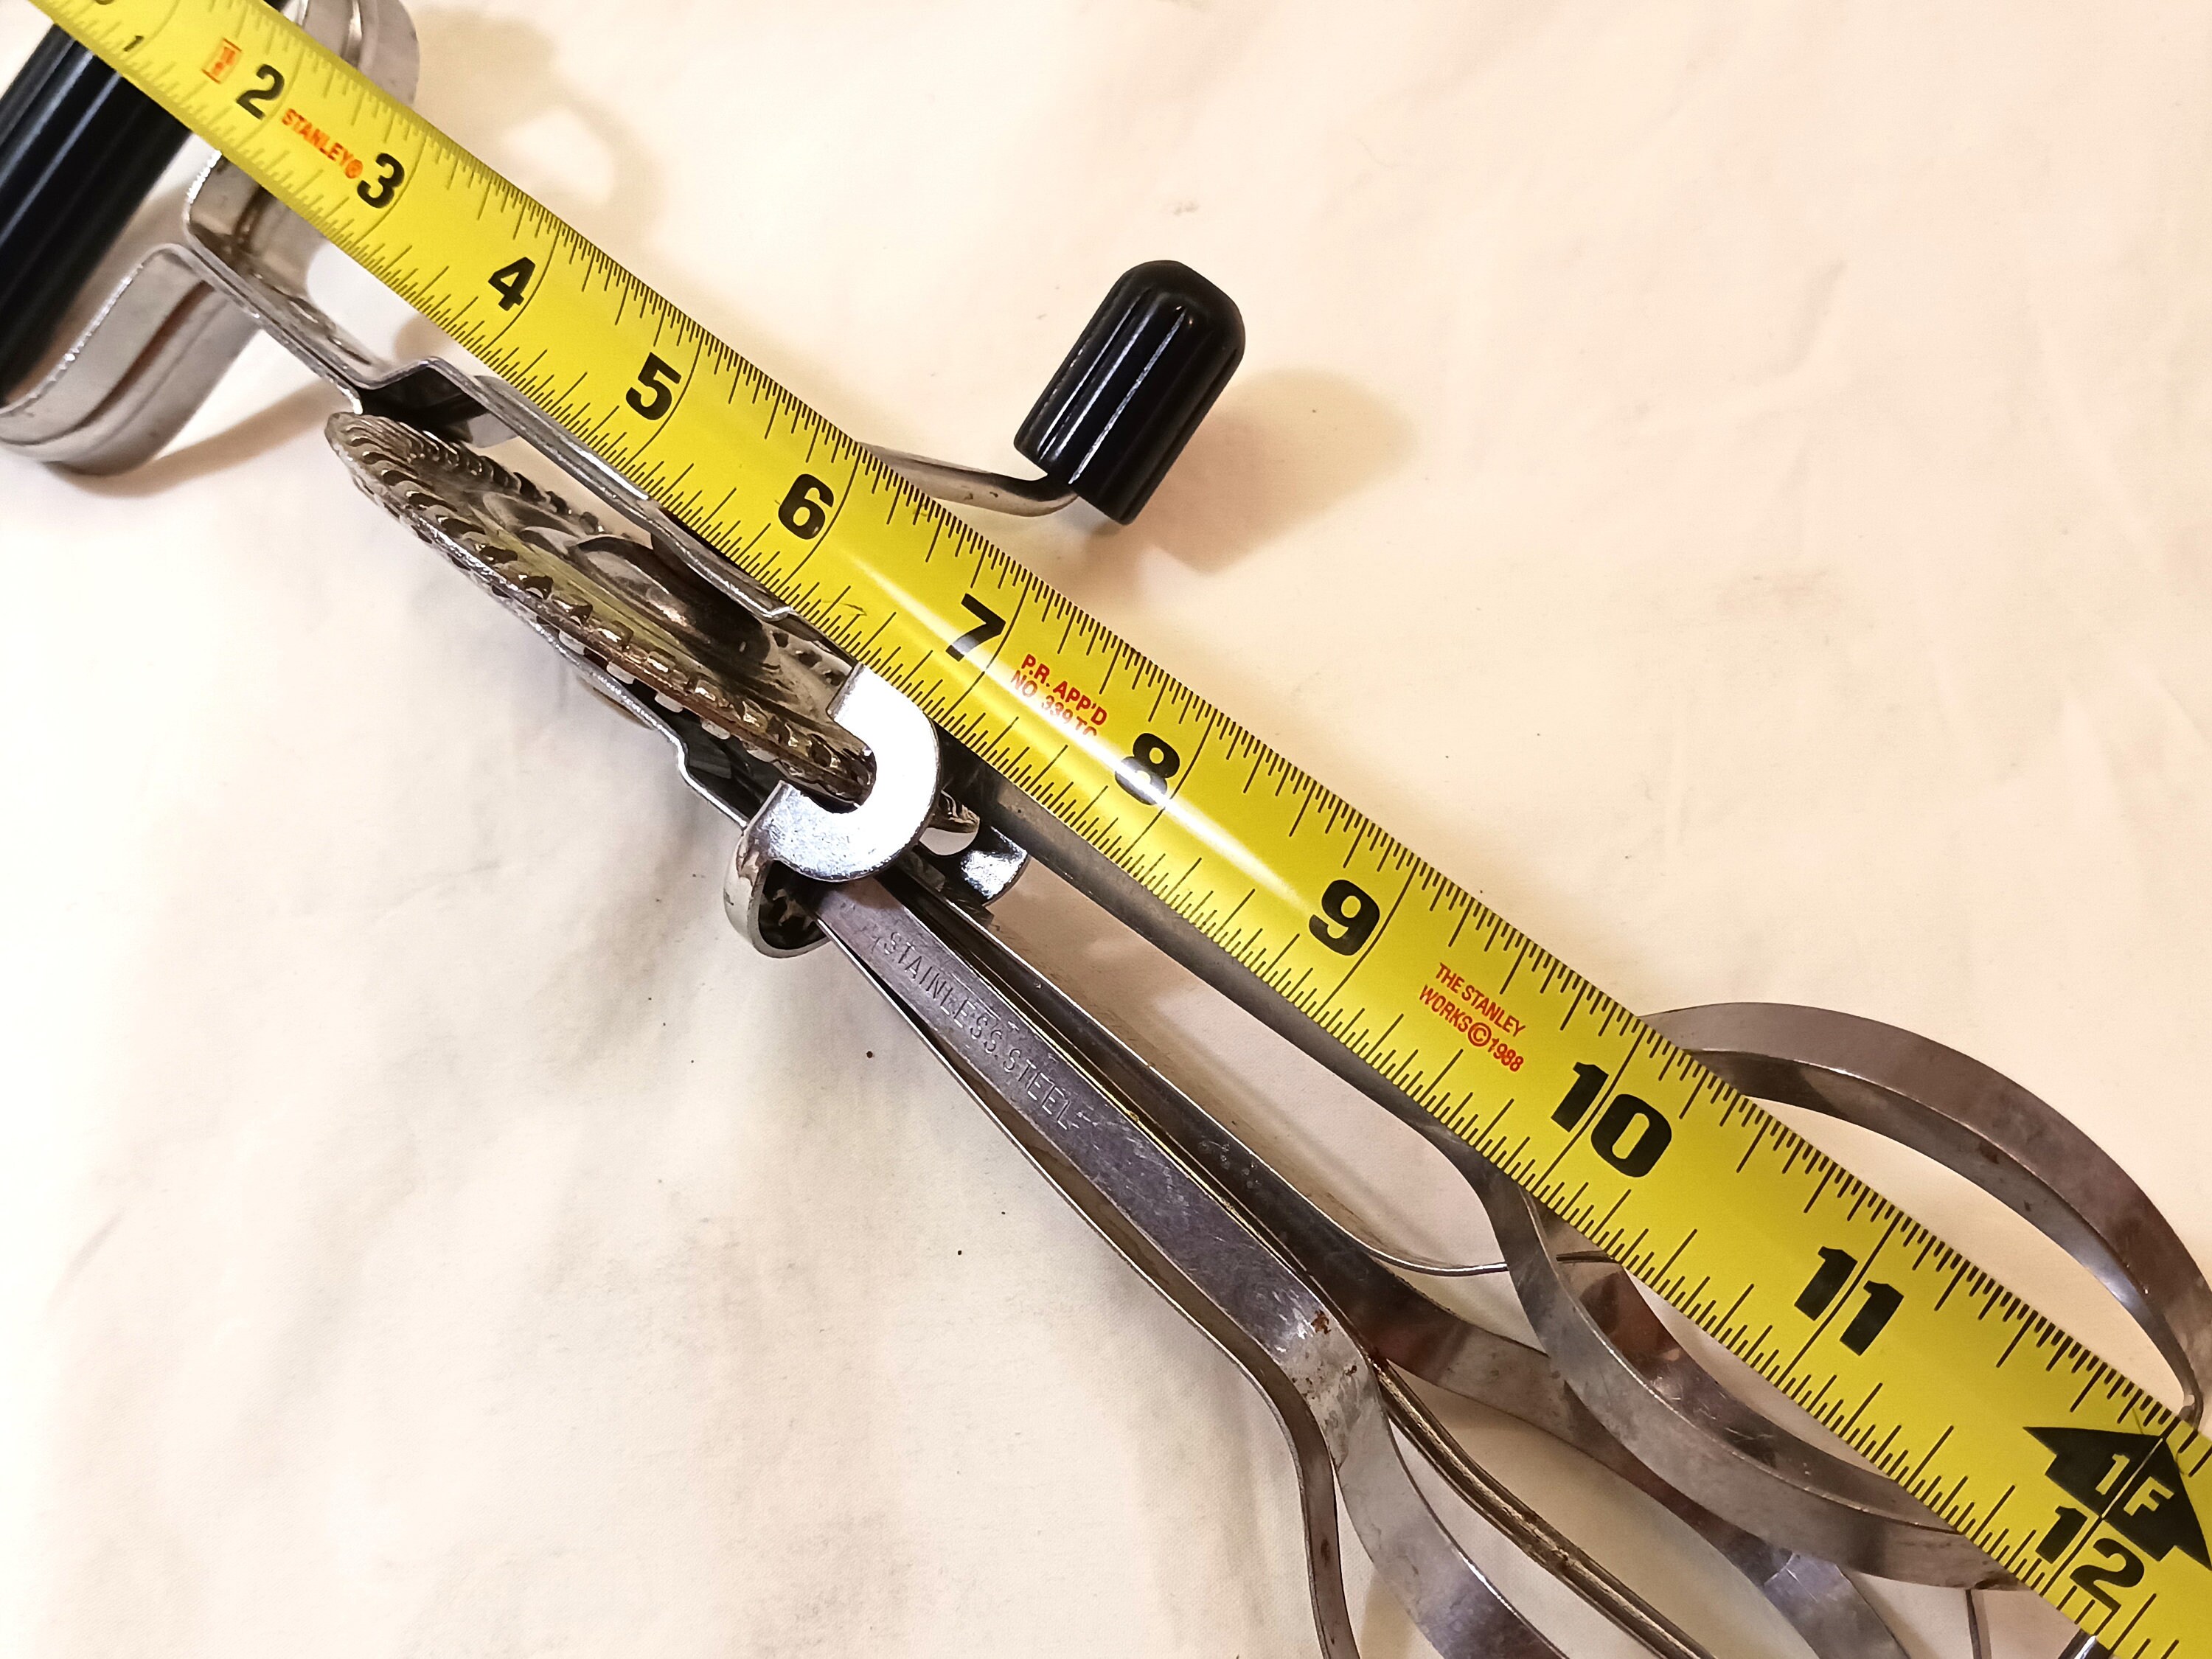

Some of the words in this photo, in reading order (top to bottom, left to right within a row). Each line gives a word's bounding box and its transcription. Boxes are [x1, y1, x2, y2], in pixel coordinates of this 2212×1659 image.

[235, 63, 285, 120] 2
[357, 153, 405, 209] 3
[487, 256, 536, 311] 4
[625, 352, 682, 420] 5
[778, 473, 835, 540] 6
[945, 593, 1006, 662] 7
[1021, 653, 1050, 687] P.R.
[1052, 681, 1107, 726] APP'D
[1114, 732, 1180, 806] 8
[1308, 879, 1380, 956] 9
[883, 931, 1004, 1055] STAINLESS
[1002, 1048, 1071, 1130] STEEL
[1435, 961, 1465, 994] THE
[1461, 984, 1526, 1037] STANLEY
[1550, 1062, 1672, 1178] 10
[1793, 1245, 1904, 1357] 11
[2095, 1453, 2175, 1517] 1F
[2034, 1505, 2145, 1613] 12
